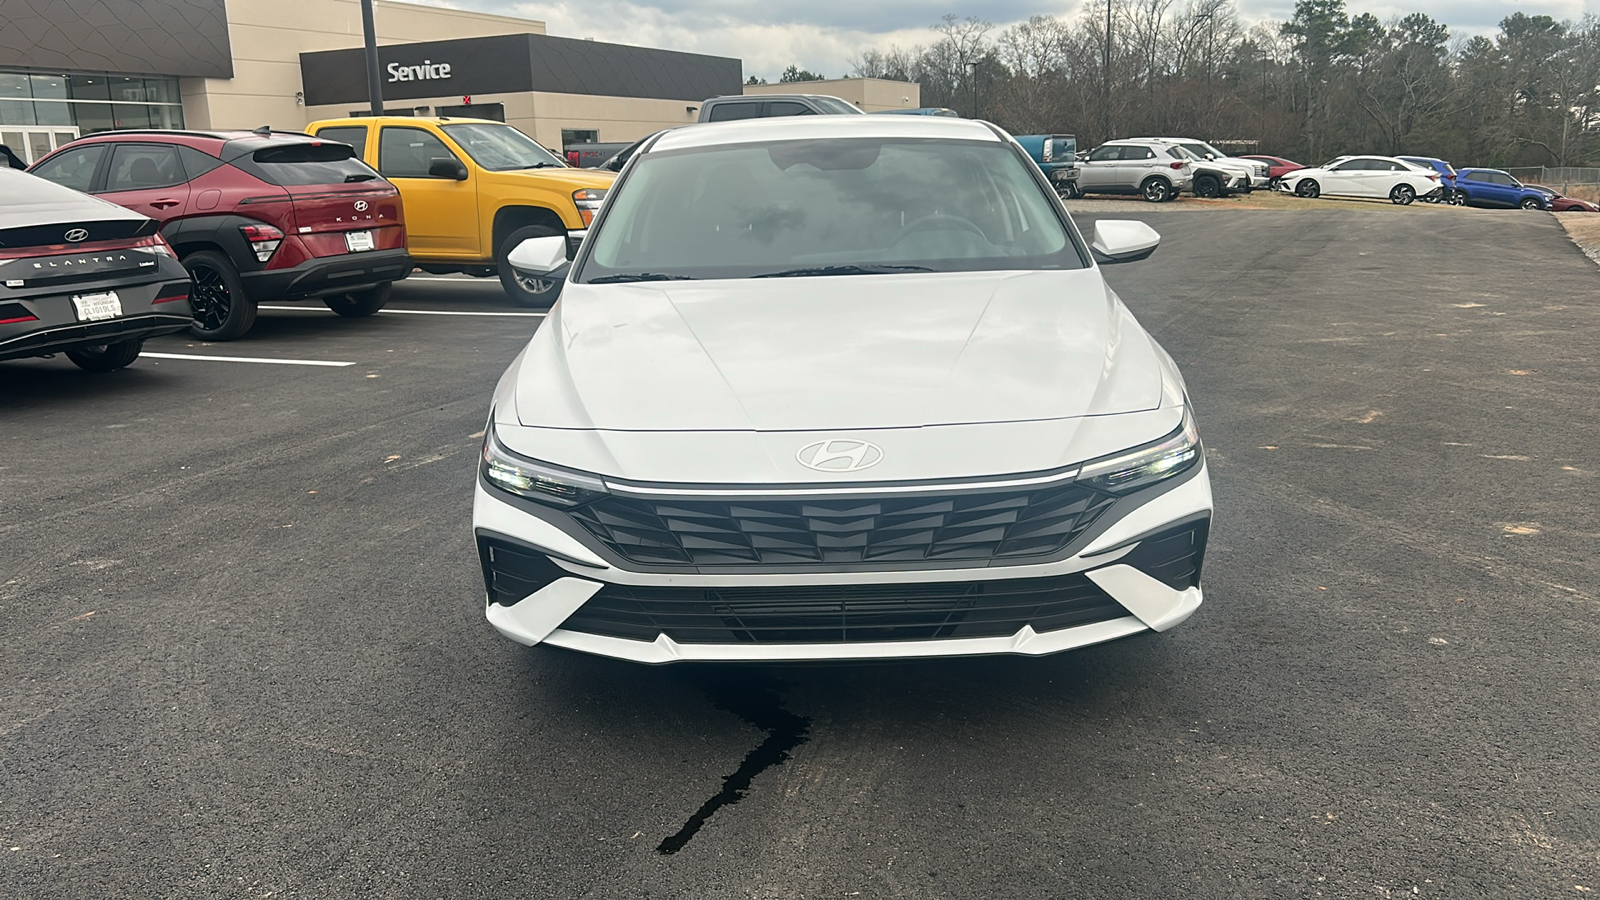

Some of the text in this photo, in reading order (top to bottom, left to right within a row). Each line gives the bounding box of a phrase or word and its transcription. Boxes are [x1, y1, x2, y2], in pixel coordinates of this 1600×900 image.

[387, 60, 451, 82] Service
[336, 213, 384, 222] KONA
[33, 255, 126, 268] ELANTRA
